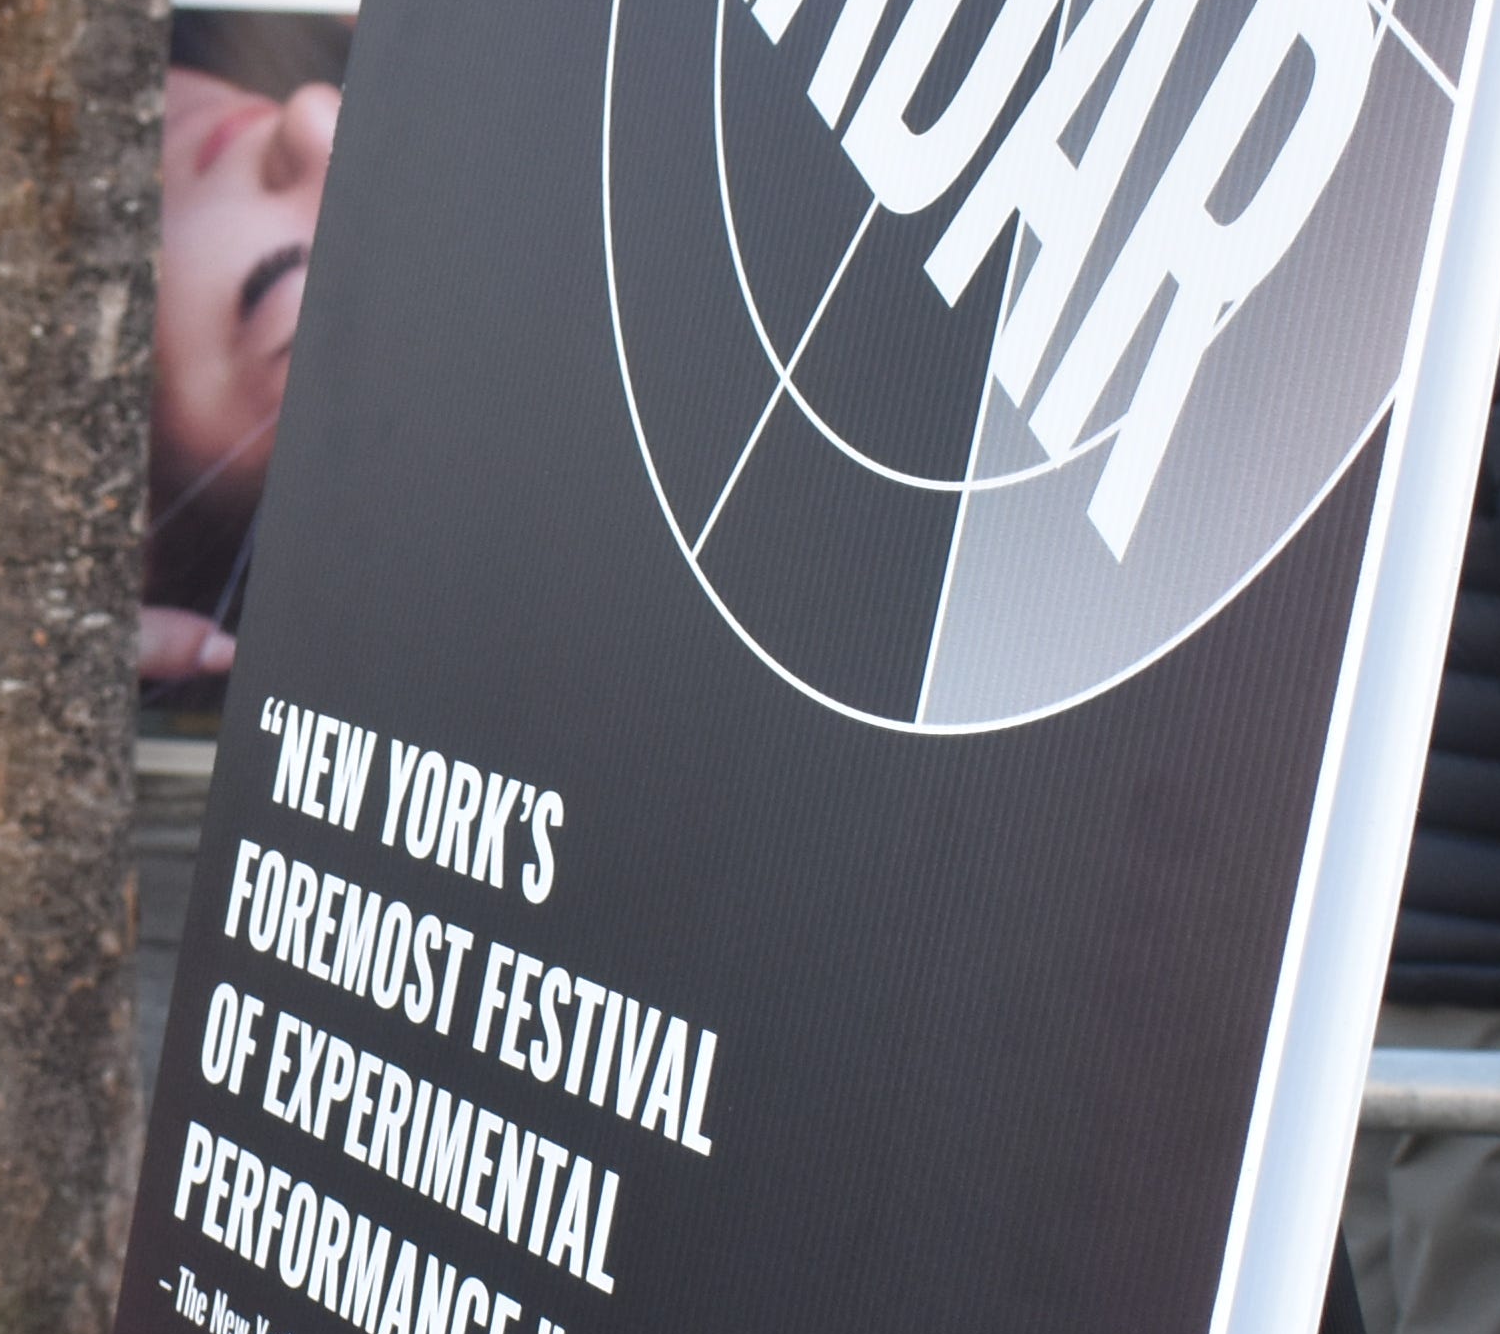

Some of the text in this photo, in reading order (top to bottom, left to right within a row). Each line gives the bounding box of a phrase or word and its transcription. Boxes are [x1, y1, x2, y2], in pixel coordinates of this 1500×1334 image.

[381, 737, 565, 906] YORK’S
[201, 981, 621, 1296] OF EXPERIMENTAL
[223, 837, 719, 1158] FOREMOST FESTIVAL
